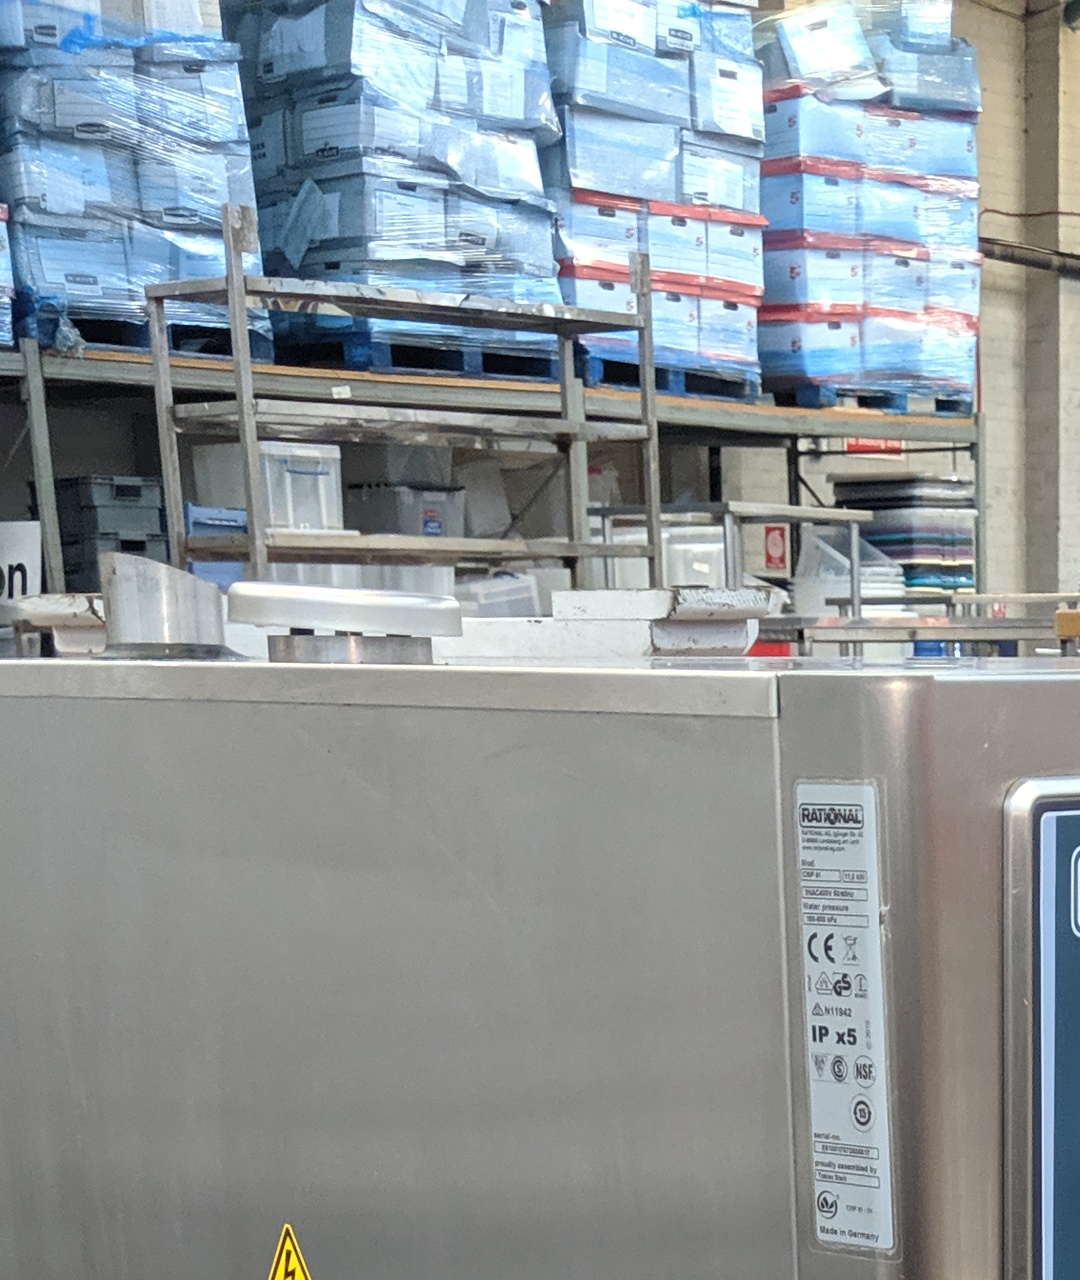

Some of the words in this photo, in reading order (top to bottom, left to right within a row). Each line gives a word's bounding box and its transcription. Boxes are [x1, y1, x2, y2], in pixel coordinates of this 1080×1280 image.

[802, 807, 862, 825] RATIONAL
[811, 1024, 830, 1043] IP
[835, 1027, 858, 1046] x5
[855, 1062, 873, 1081] NSF
[819, 1225, 838, 1236] Made
[839, 1227, 847, 1237] in
[847, 1229, 880, 1243] Germany
